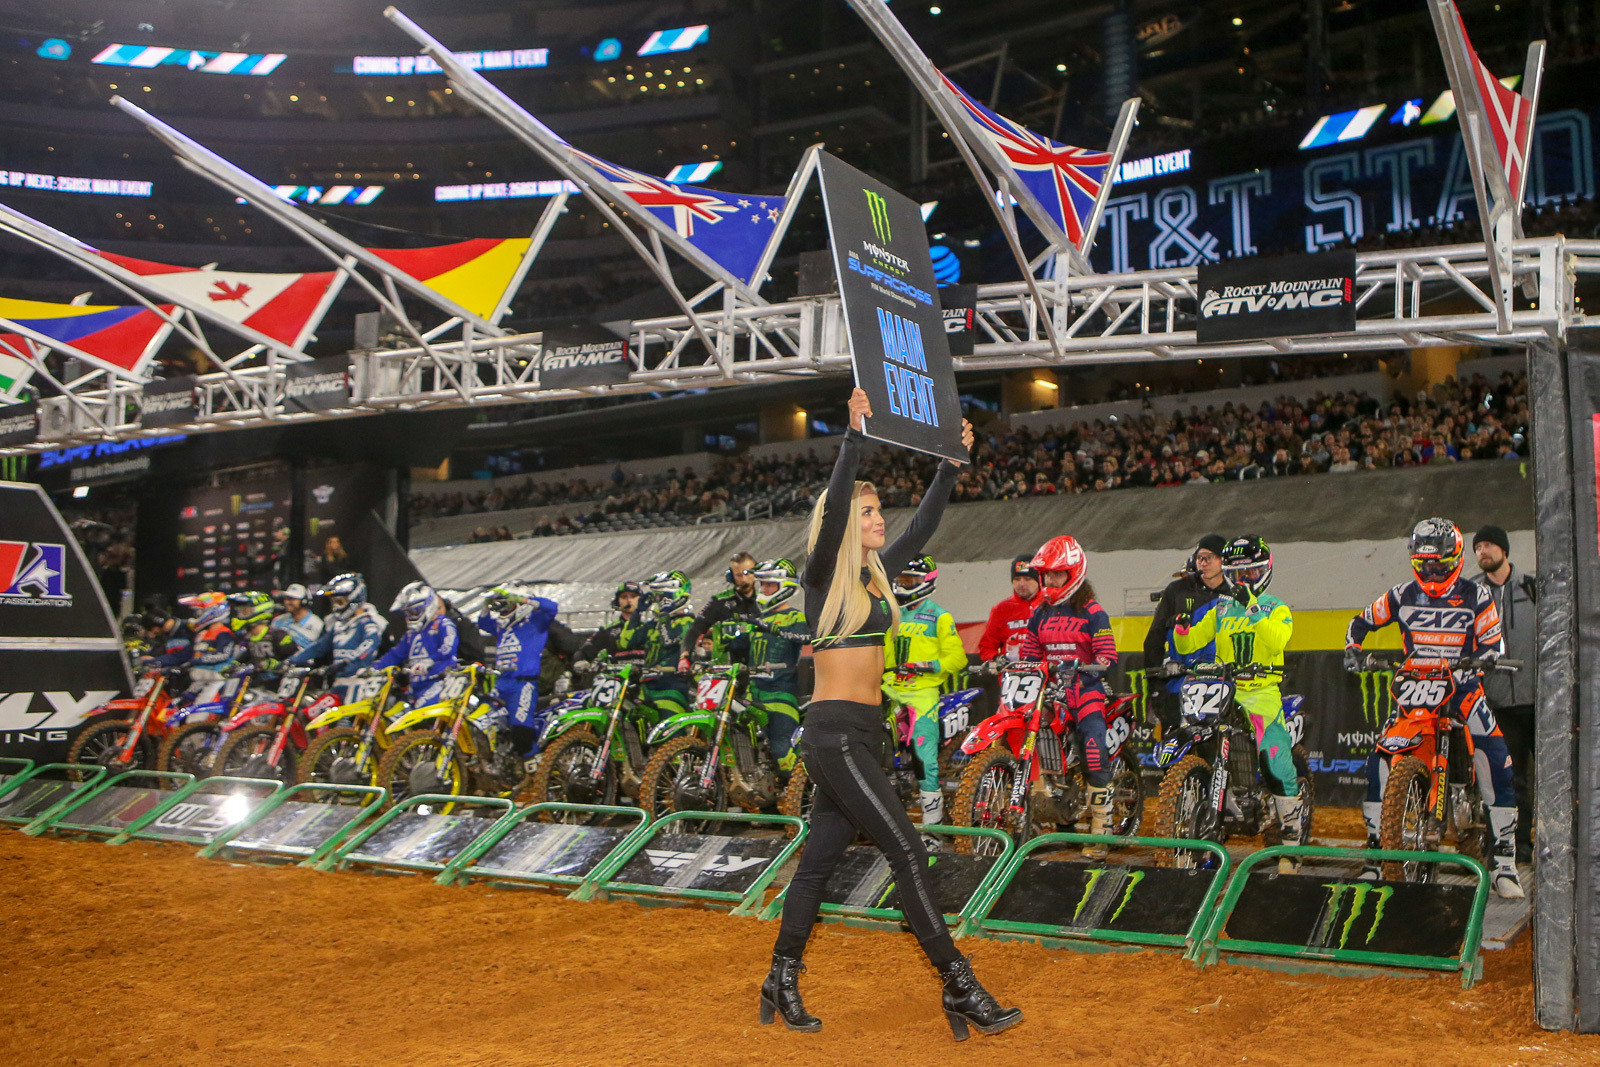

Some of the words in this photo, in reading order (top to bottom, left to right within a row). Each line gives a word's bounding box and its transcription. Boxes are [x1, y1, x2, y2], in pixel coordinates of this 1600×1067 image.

[1122, 157, 1154, 182] MAIN
[1154, 149, 1191, 175] EVENT
[1092, 168, 1275, 276] T&T
[848, 257, 933, 305] SUPERCROSS
[872, 258, 905, 276] ENERGY
[1222, 285, 1267, 298] ROCKY
[1268, 278, 1343, 295] MOUNTAIN
[877, 306, 928, 372] MAIN
[883, 361, 939, 427] EVENT
[1405, 610, 1471, 629] FXR
[1414, 633, 1441, 642] RACE
[697, 679, 729, 706] 24
[1001, 675, 1042, 704] 93
[1183, 683, 1230, 714] 32
[1399, 680, 1448, 706] 285
[943, 706, 969, 738] 66
[1105, 715, 1130, 755] 93
